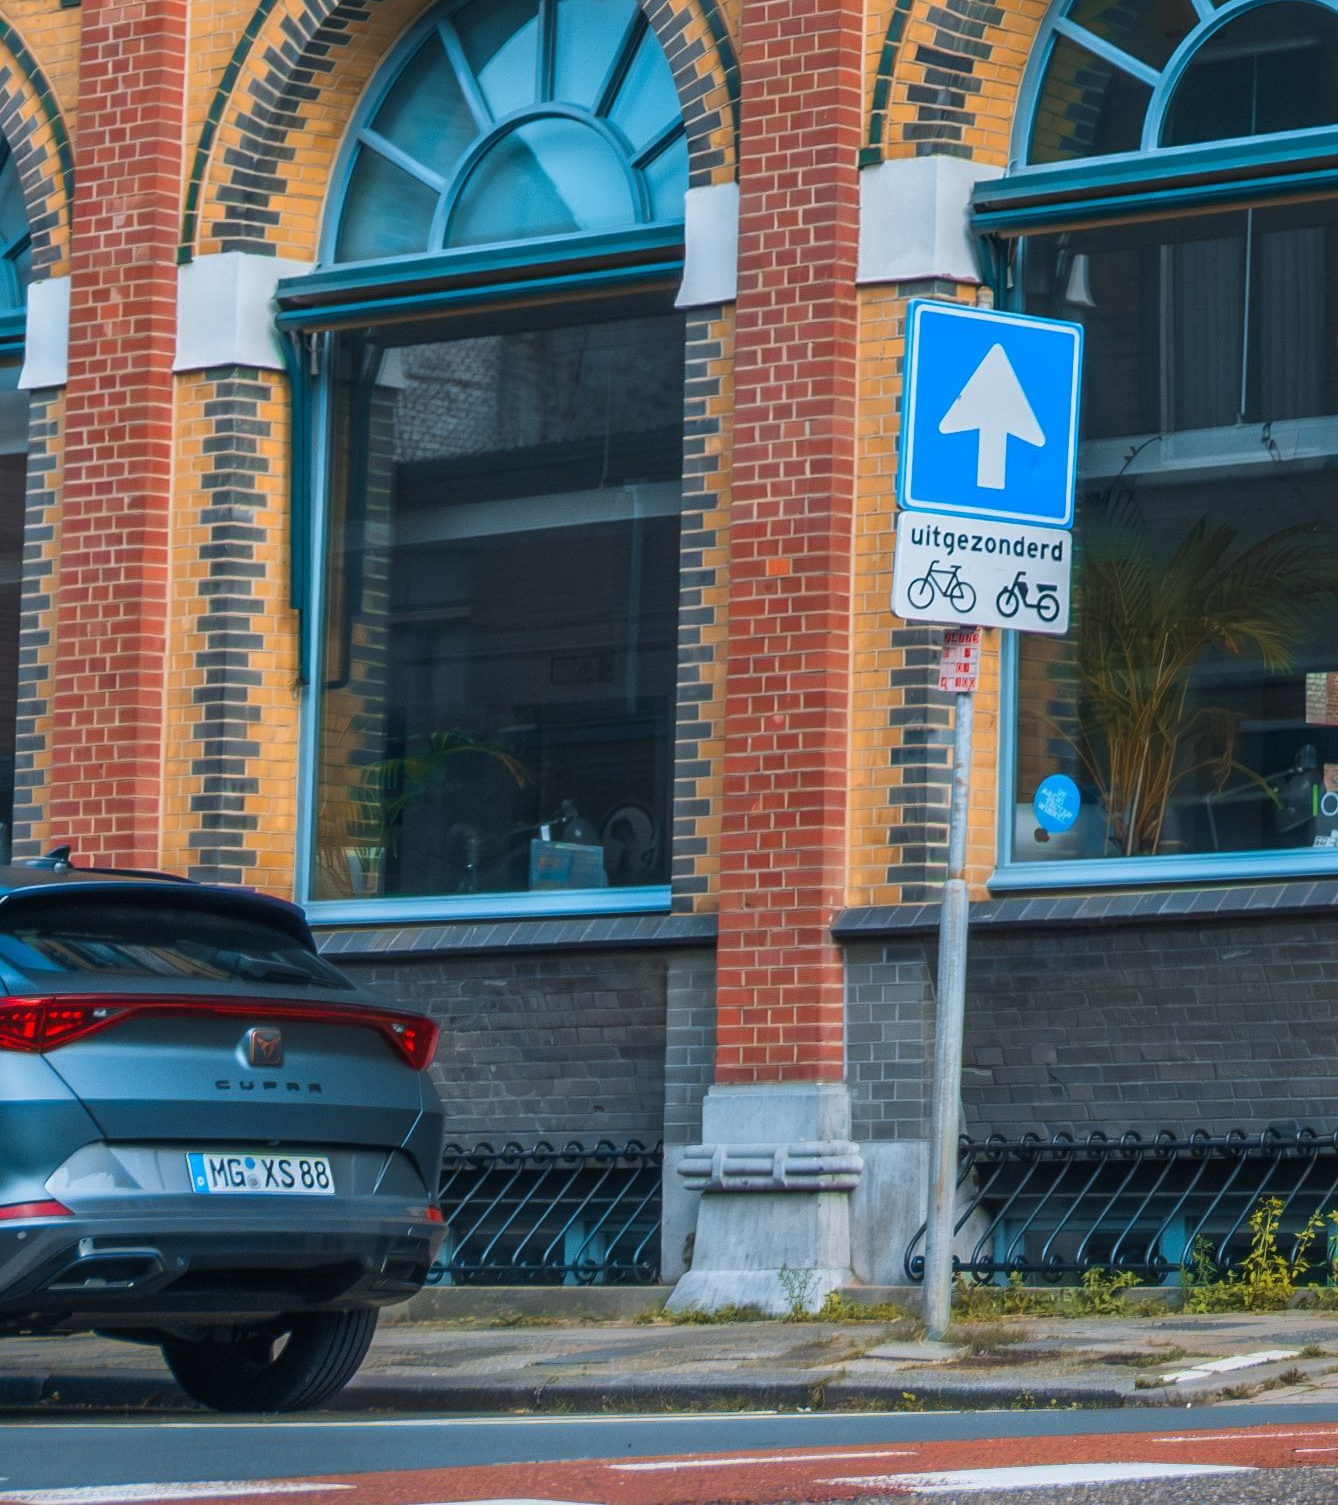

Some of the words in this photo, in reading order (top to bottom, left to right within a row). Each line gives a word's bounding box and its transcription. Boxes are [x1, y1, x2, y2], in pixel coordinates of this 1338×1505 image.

[911, 524, 1064, 562] uitgezonderd
[215, 1080, 322, 1093] CUPRA
[209, 1158, 246, 1187] MG
[261, 1159, 295, 1188] XS
[299, 1160, 330, 1189] 88
